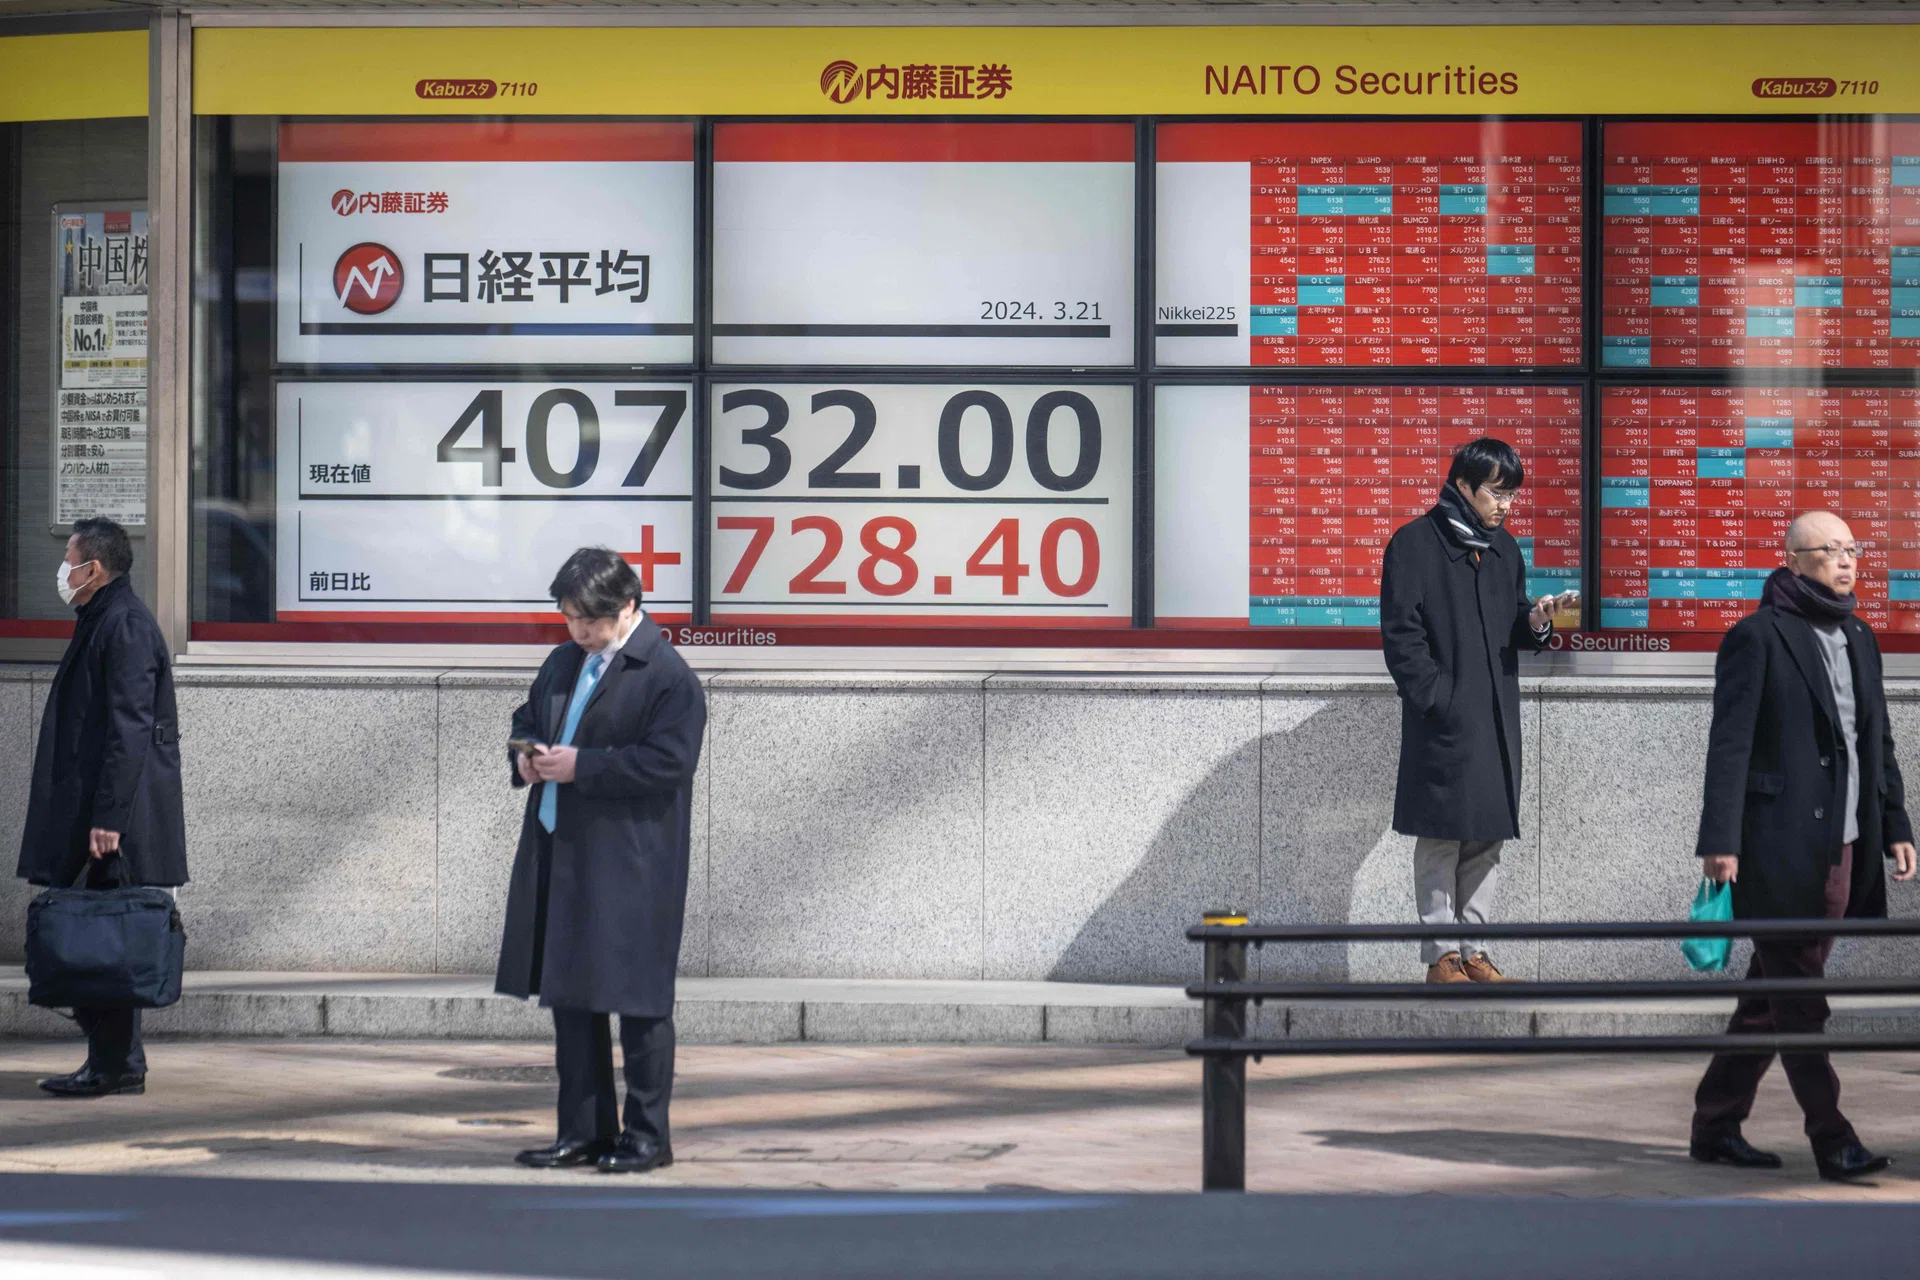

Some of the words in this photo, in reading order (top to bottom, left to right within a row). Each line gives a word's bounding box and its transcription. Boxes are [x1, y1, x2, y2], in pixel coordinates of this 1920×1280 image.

[866, 63, 1012, 100] 内藤証券
[1206, 65, 1320, 95] NAITO
[1334, 64, 1519, 95] Securities
[423, 82, 490, 96] Kabuスタ
[500, 82, 538, 96] 7110
[1760, 81, 1829, 95] Kabuスタ
[1840, 80, 1879, 95] 7110
[1260, 156, 1288, 164] ニッスイ
[1310, 156, 1332, 164] INPEX
[1277, 166, 1296, 174] 973.8
[1321, 166, 1344, 174] 2300.5
[1281, 176, 1297, 184] +8.5
[1325, 176, 1344, 184] +33.0
[1260, 187, 1288, 195] DeNA
[358, 191, 449, 214] 内藤証券
[1274, 196, 1297, 204] 1510.0
[1278, 206, 1297, 214] +12.0
[1310, 216, 1332, 225] クラレ
[1402, 216, 1429, 224] SUMCO
[1322, 226, 1344, 234] 1606.0
[1415, 226, 1438, 234] 2510.0
[1325, 236, 1344, 244] +27.0
[1415, 236, 1438, 244] +119.5
[1260, 246, 1288, 255] 三井化学
[1449, 246, 1478, 254] メルカリ
[1279, 256, 1296, 264] 4542
[1463, 256, 1486, 264] 2004.0
[1467, 266, 1486, 274] +24.0
[423, 248, 650, 304] 日経平均
[1263, 277, 1284, 285] DIC
[1273, 286, 1296, 294] 2945.5
[1277, 296, 1296, 304] +46.5
[980, 301, 1042, 320] 2024.
[1053, 301, 1103, 320] 3.21
[1158, 306, 1236, 320] Nikkei225
[1421, 316, 1438, 324] 4225
[1307, 337, 1335, 345] フジクラ
[1449, 337, 1478, 345] オークマ
[1321, 347, 1344, 355] 2090.0
[1324, 356, 1344, 364] +35.5
[1468, 356, 1486, 364] +186
[1263, 387, 1283, 395] NTN
[1277, 397, 1296, 405] 322.3
[1280, 407, 1296, 415] +5.3
[1259, 417, 1288, 425] シャープ
[1358, 417, 1378, 425] TDK
[1276, 427, 1295, 435] 839.6
[1373, 427, 1390, 435] 7530
[1277, 437, 1295, 445] +10.6
[1377, 437, 1390, 445] +22
[1322, 457, 1343, 465] 13445
[1420, 457, 1437, 465] 3704
[309, 463, 371, 484] 現在値
[1326, 467, 1343, 475] +595
[1424, 467, 1437, 475] +74
[1262, 477, 1284, 485] ニコン
[1273, 487, 1295, 495] 1652.0
[1276, 497, 1295, 505] +49.5
[1261, 537, 1284, 545] みずほ
[1544, 539, 1571, 547] MS&AD
[1278, 547, 1295, 555] 3029
[1563, 548, 1580, 557] 8035
[1276, 557, 1295, 565] +77.5
[1563, 558, 1580, 566] +279
[1309, 567, 1331, 576] 小田急
[309, 571, 371, 592] 前日比
[1320, 577, 1343, 585] 2187.5
[1327, 587, 1343, 595] +7.0
[1262, 597, 1282, 605] NTT
[1306, 598, 1332, 606] KDDI
[1277, 607, 1295, 615] 180.3
[1325, 608, 1342, 616] 4551
[1282, 617, 1295, 625] -1.8
[1331, 617, 1343, 625] -70
[679, 628, 777, 645] Securities
[1570, 633, 1671, 651] Securities
